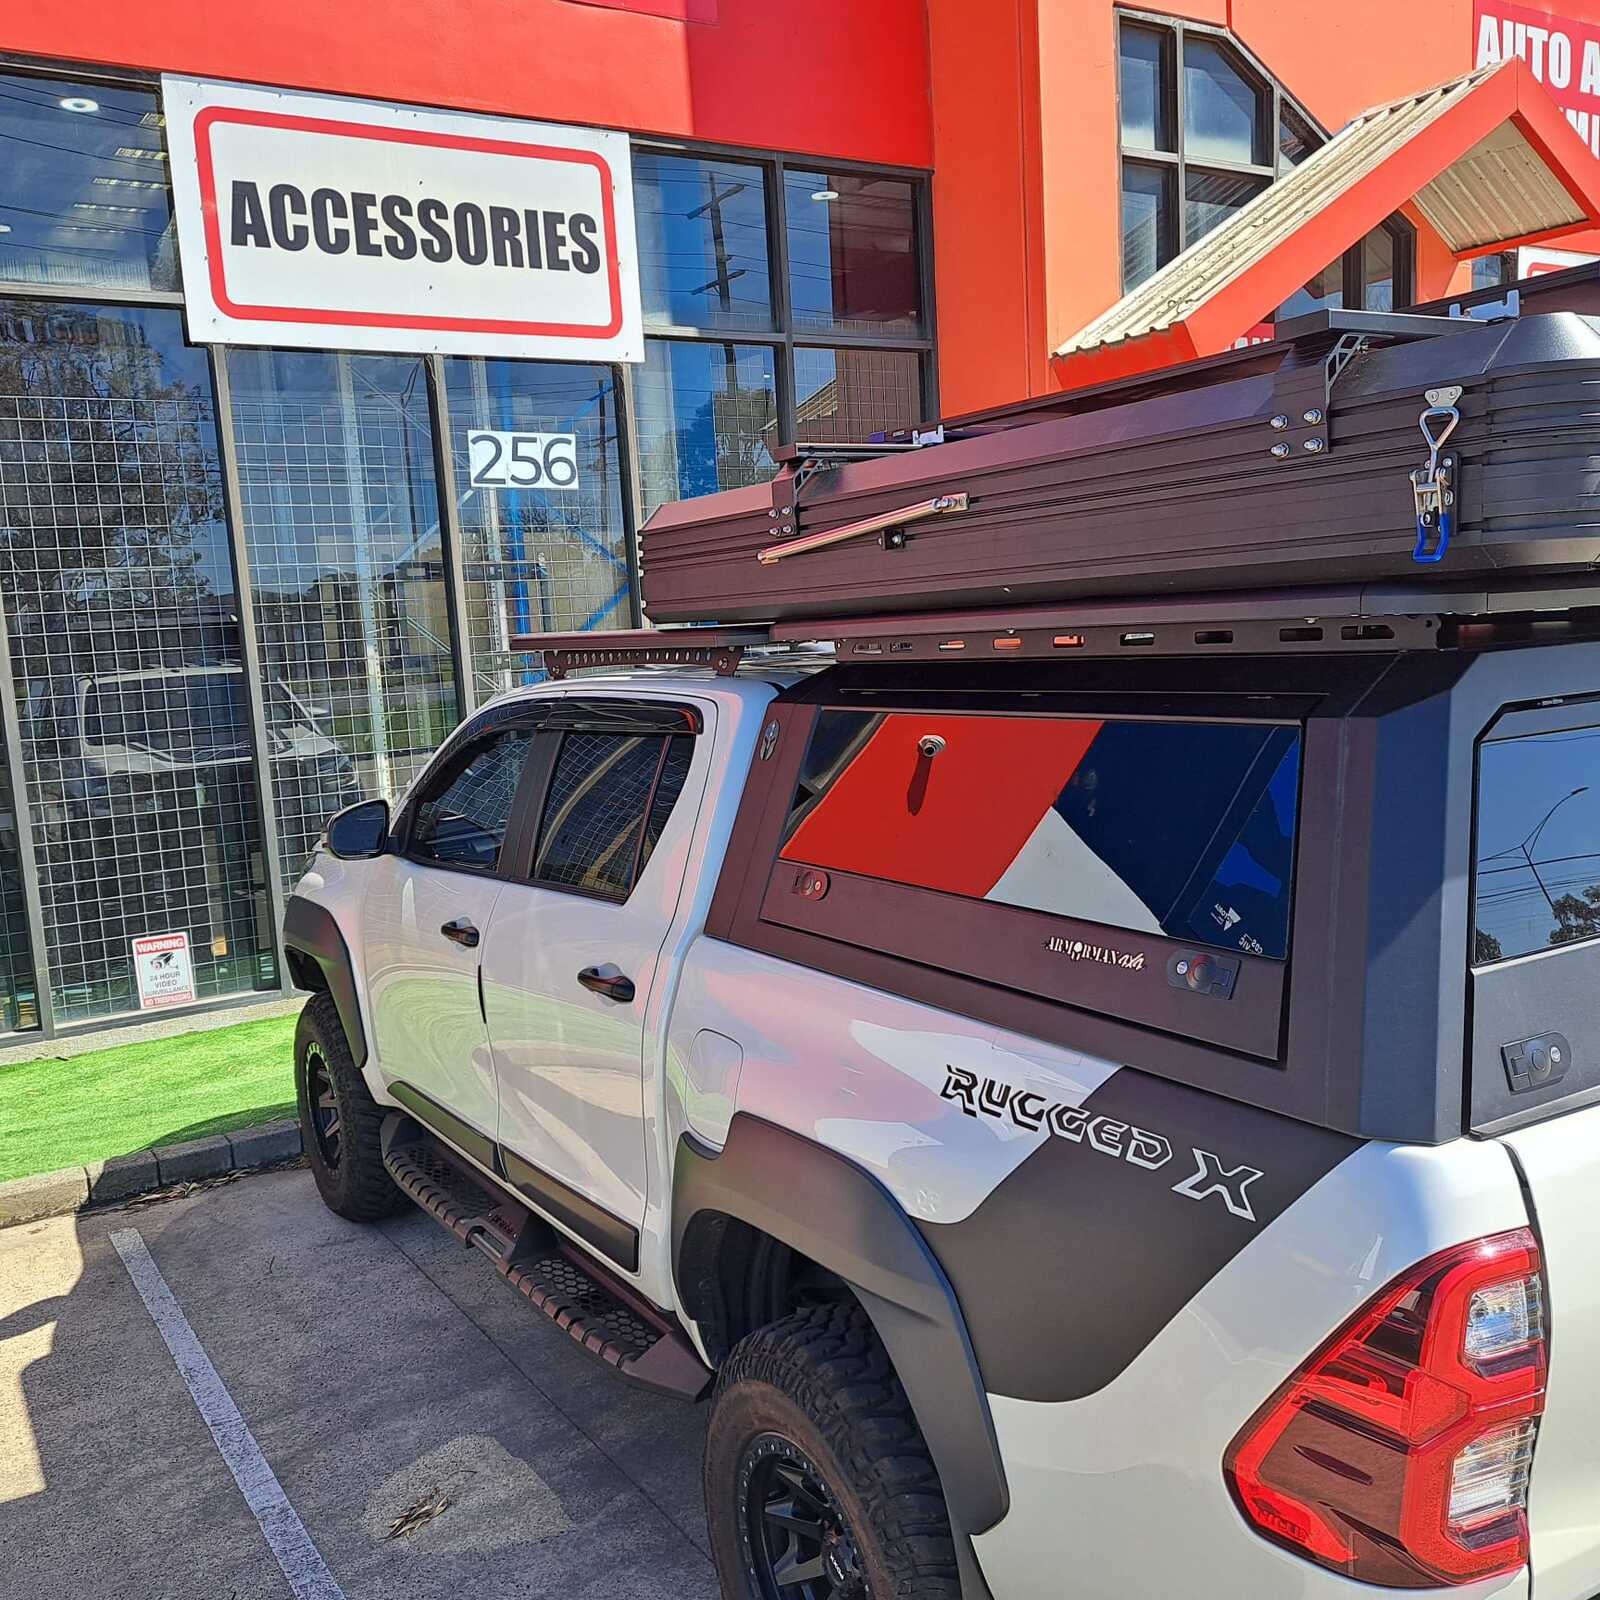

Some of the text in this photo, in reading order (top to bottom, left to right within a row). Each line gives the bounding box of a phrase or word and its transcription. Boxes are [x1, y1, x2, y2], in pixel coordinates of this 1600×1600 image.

[1476, 14, 1571, 89] AUTO
[231, 180, 600, 274] ACCESSORIES
[470, 433, 577, 486] 256
[136, 938, 185, 953] WARNING
[154, 980, 178, 988] VIDEO
[159, 970, 181, 980] HOUR
[940, 1064, 1264, 1222] RUGGED X
